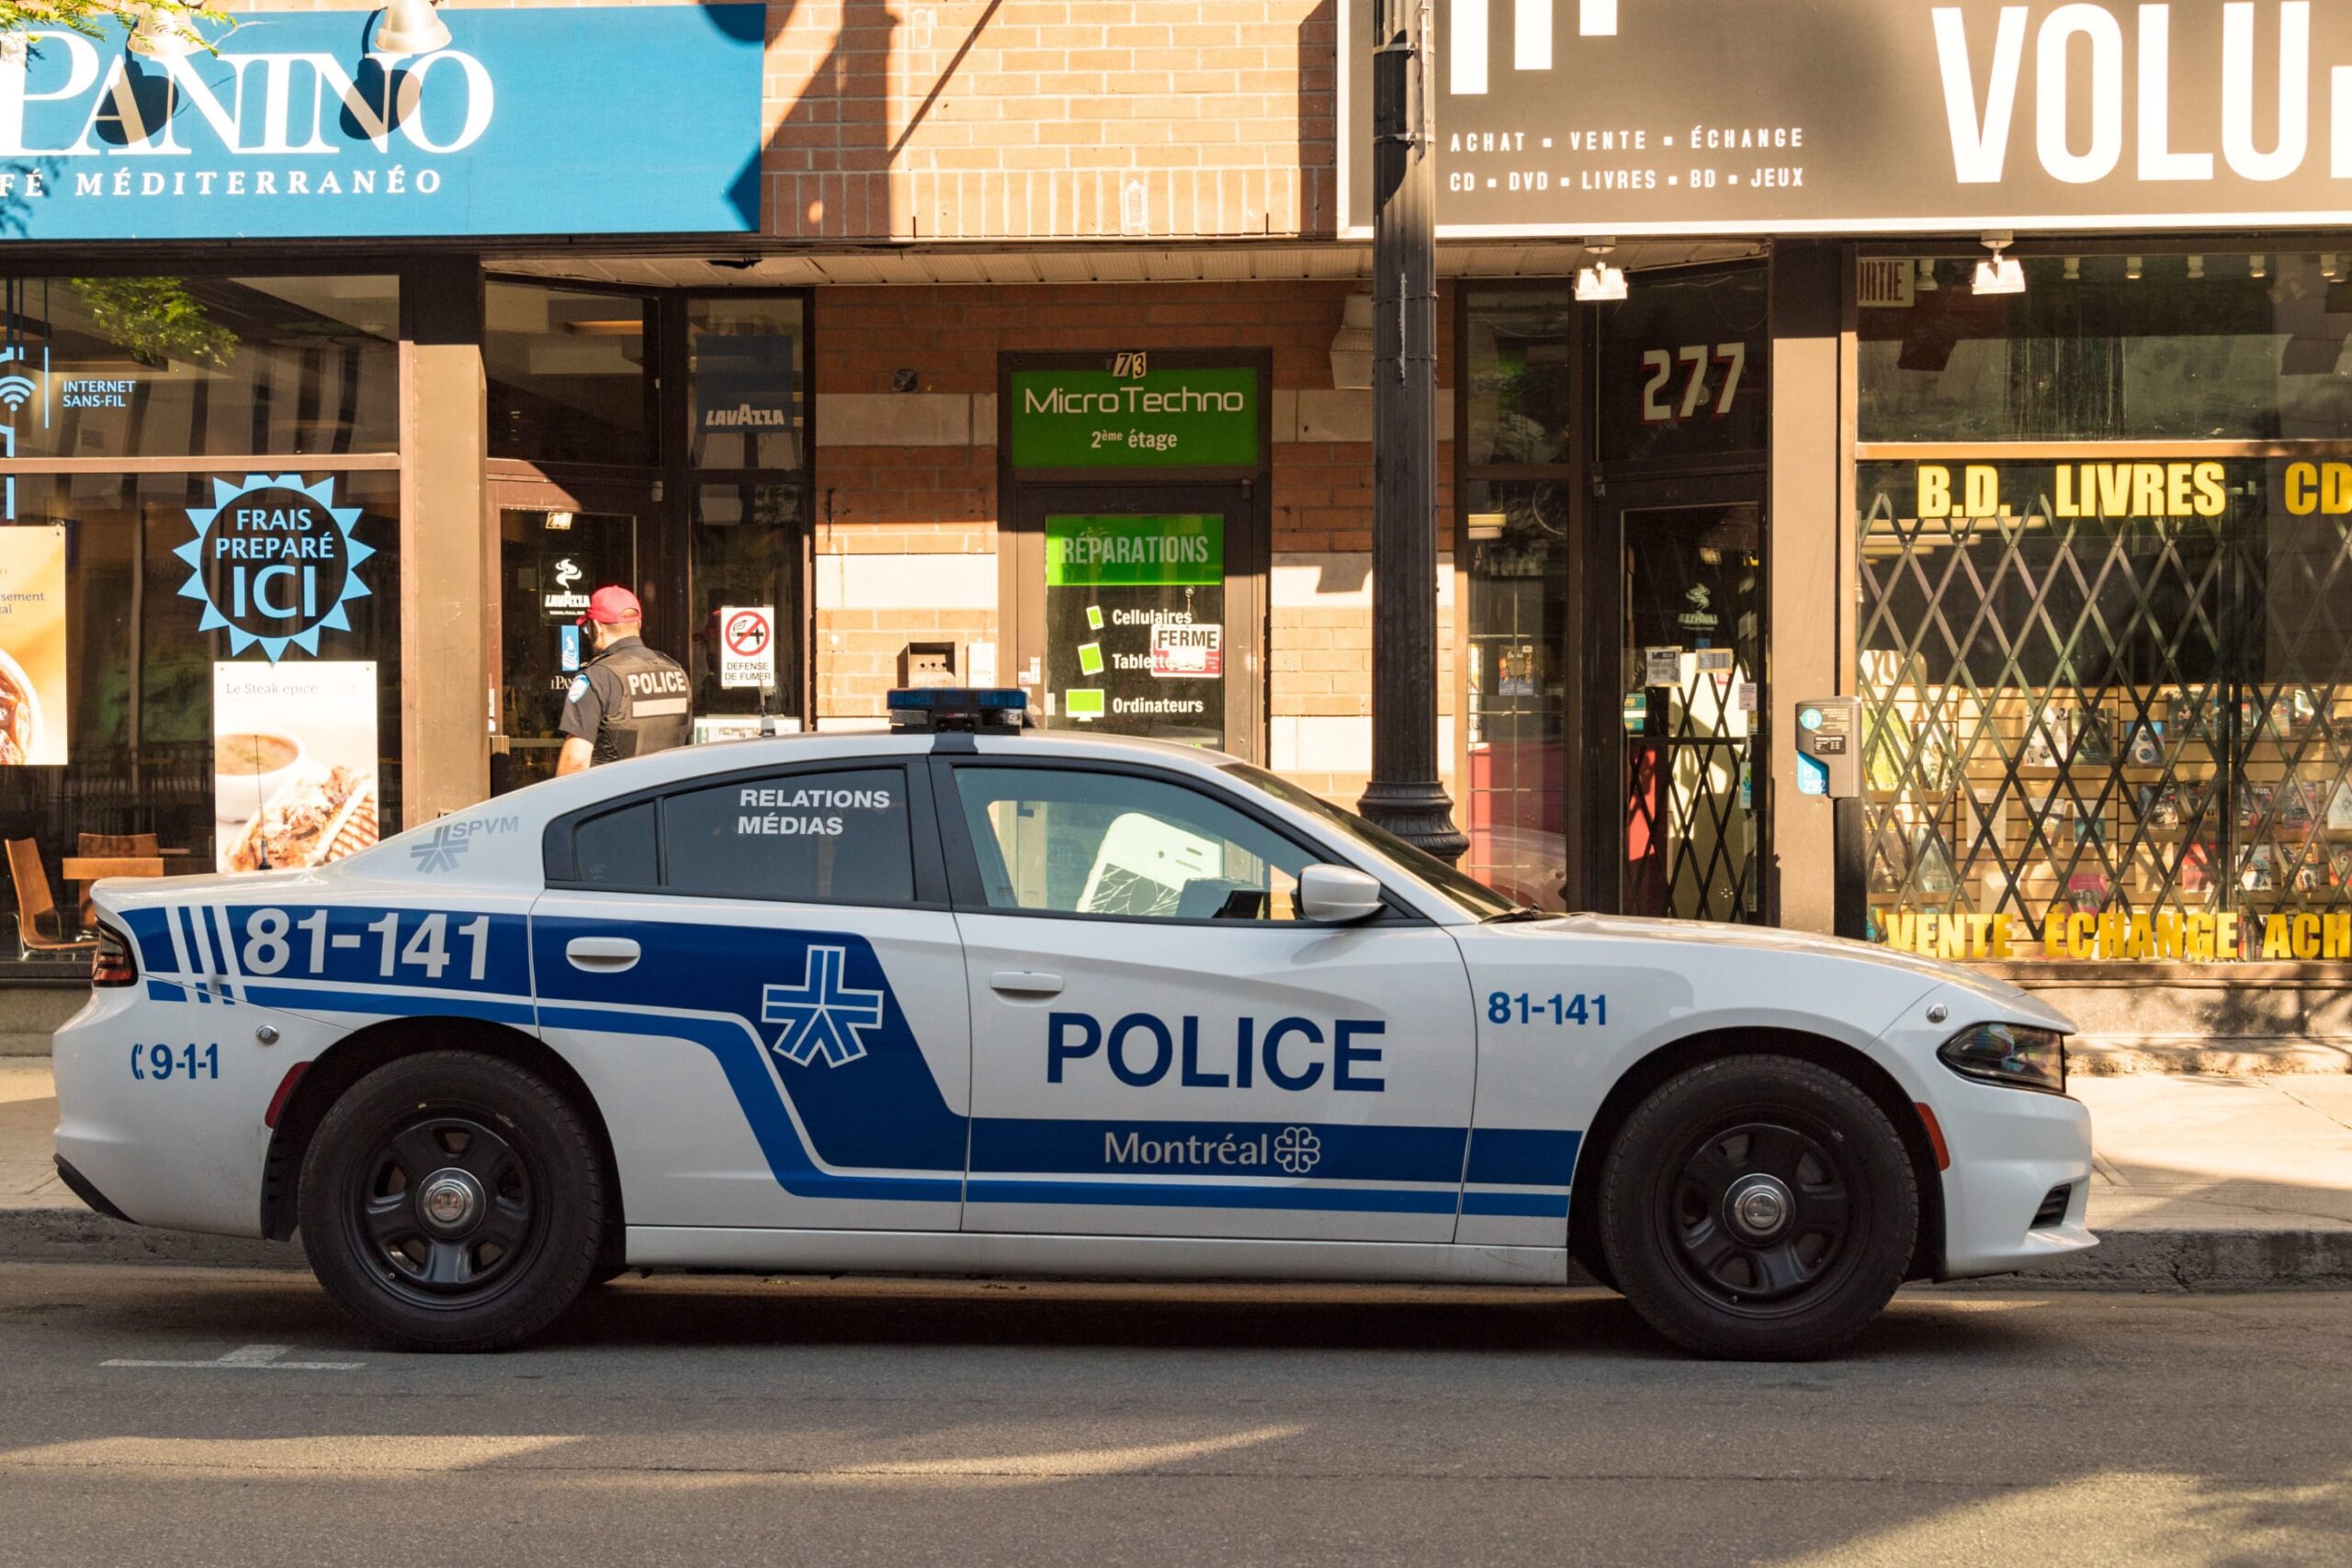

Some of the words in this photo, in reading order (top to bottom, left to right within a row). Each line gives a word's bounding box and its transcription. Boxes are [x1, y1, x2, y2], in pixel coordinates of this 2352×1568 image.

[1931, 1, 2352, 184] VOLU
[1450, 132, 1525, 152] ACHAT
[1570, 130, 1646, 151] VENTE
[1690, 125, 1804, 149] ÉCHANGE
[74, 164, 441, 197] MÉDITERRANÉO
[1449, 173, 1476, 191] CD
[1509, 172, 1548, 191] DVD
[1581, 170, 1657, 190] LIVRES
[1690, 169, 1716, 188] BD
[1750, 167, 1804, 187] JEUX
[62, 380, 136, 393] INTERNET
[1642, 342, 1746, 422] 277
[62, 395, 127, 407] SANS-FIL
[1024, 386, 1244, 414] MicroTechno
[705, 403, 785, 427] LAVAZZA
[1091, 429, 1123, 449] 2ème
[1128, 429, 1178, 451] étage
[1917, 465, 2011, 518] B.D.
[2055, 461, 2225, 517] LIVRES
[237, 509, 312, 531] FRAIS
[215, 532, 334, 558] PREPARÉ
[1060, 531, 1209, 565] RÉPARATIONS
[233, 566, 316, 618] ICI
[1112, 609, 1193, 626] Cellulaires
[1112, 653, 1182, 670] Tablette
[226, 682, 242, 694] Le
[244, 682, 279, 694] Steak
[628, 671, 687, 695] POLICE
[725, 672, 737, 681] DE
[740, 672, 772, 681] FUMER
[1112, 697, 1204, 714] Ordinateurs
[740, 788, 891, 809] RELATIONS
[451, 814, 520, 839] SPVM
[737, 812, 844, 837] MÉDIAS
[243, 908, 490, 980] 81-141
[1886, 913, 2014, 958] VENTE
[2044, 904, 2238, 960] ÉCHANGE
[1488, 991, 1608, 1026] 81-141
[150, 1043, 220, 1079] 9-1-1
[1047, 1011, 1385, 1092] POLICE
[1103, 1129, 1269, 1168] Montréal
